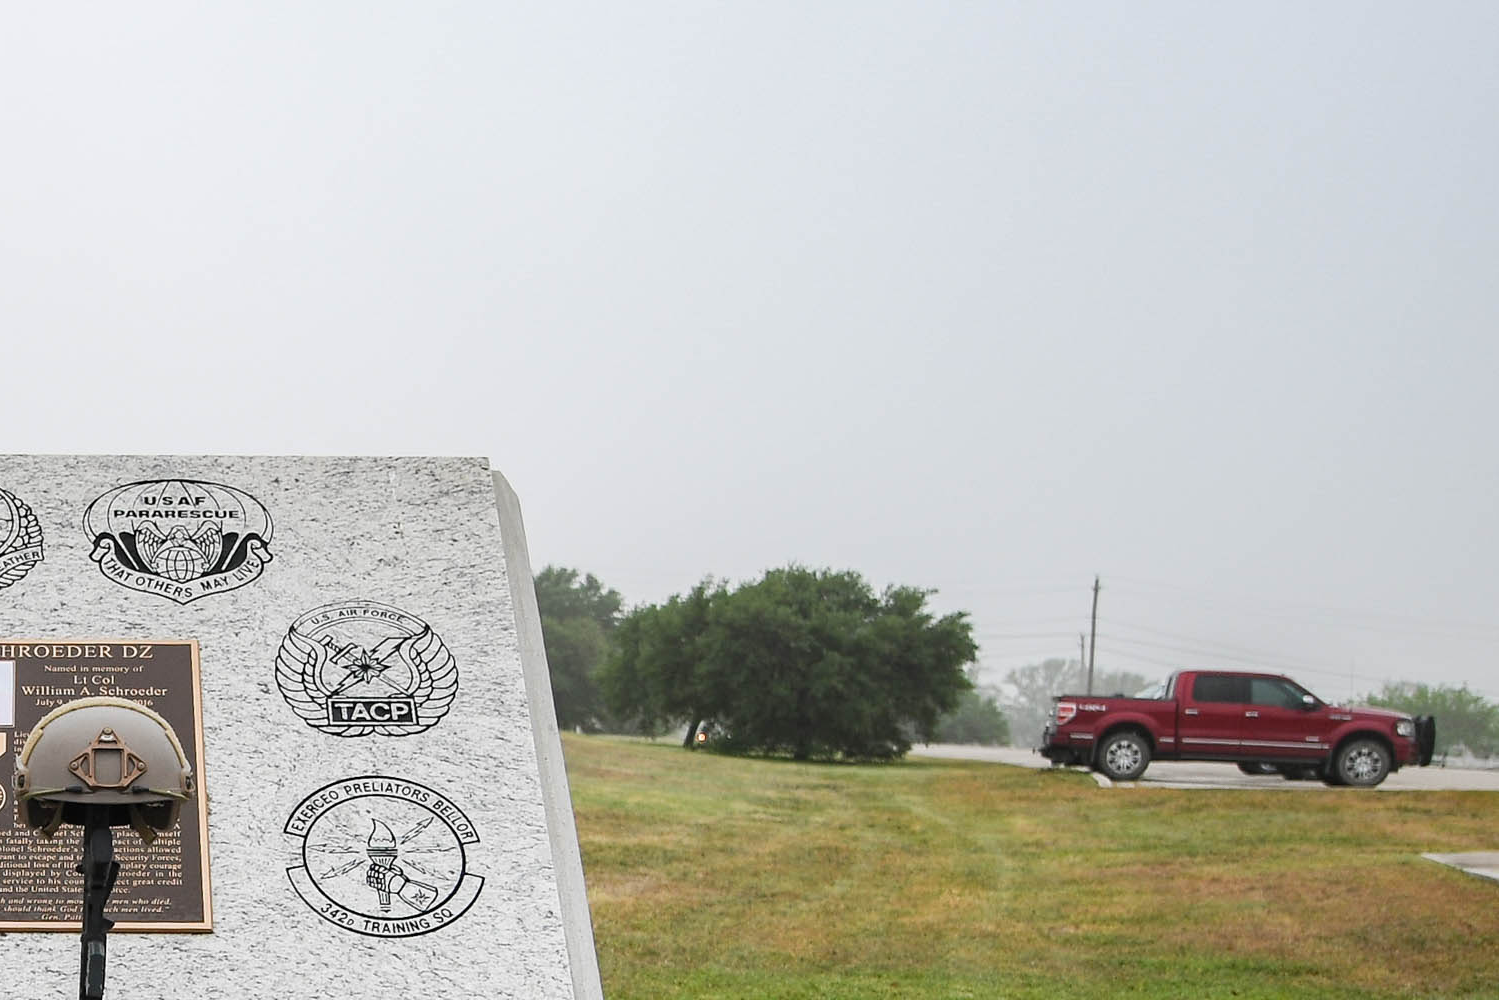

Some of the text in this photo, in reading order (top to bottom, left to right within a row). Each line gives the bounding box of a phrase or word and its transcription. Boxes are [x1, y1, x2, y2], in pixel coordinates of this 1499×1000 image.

[144, 496, 206, 506] USAF
[114, 510, 239, 519] PARARESCUE
[104, 558, 259, 598] THAT OTHERS MAY LIVE
[338, 609, 358, 617] AIR
[363, 609, 404, 624] FORCE
[122, 645, 153, 658] DZ
[44, 665, 77, 673] Named
[92, 666, 130, 674] memory
[133, 665, 144, 673] of
[73, 675, 115, 685] Lt Col
[21, 686, 168, 696] William A. Schroeder
[35, 699, 55, 707] July
[334, 702, 409, 721] TACP
[291, 782, 474, 840] EXERCEO PRELIATORS BELLOR
[14, 829, 30, 837] and
[6, 837, 33, 845] fatally
[28, 854, 57, 862] escape
[114, 854, 149, 862] Security
[2, 869, 46, 878] displayed
[50, 869, 61, 878] by
[132, 879, 154, 887] great
[157, 878, 183, 886] credit
[363, 919, 431, 934] TRAINING
[432, 908, 454, 924] SQ
